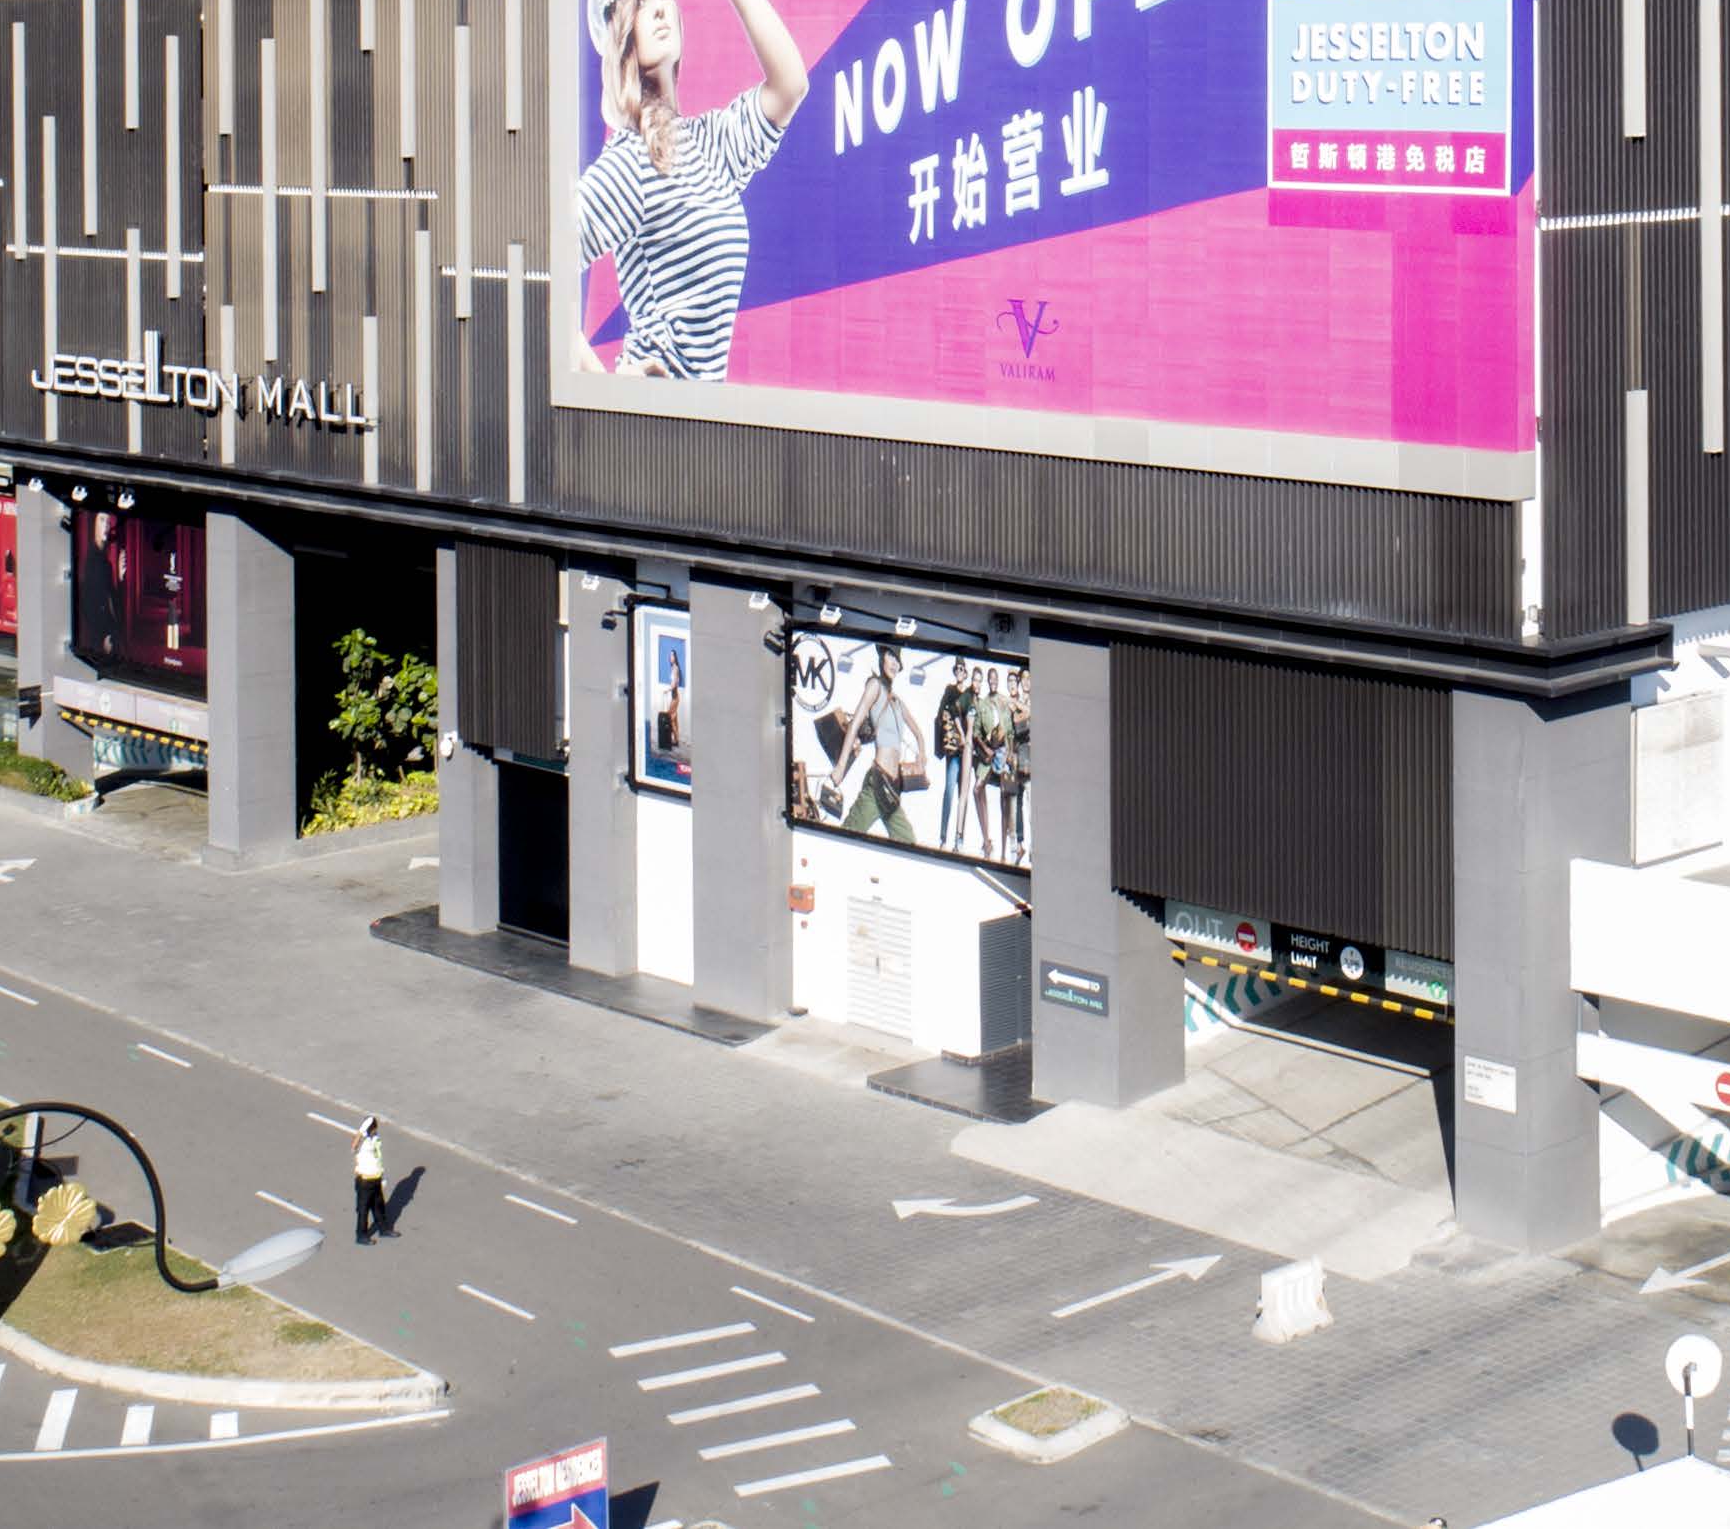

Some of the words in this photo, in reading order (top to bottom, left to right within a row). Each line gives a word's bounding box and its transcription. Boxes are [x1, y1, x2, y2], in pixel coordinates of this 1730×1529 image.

[1290, 21, 1486, 63] JESSELTON
[1290, 70, 1487, 106] DUTY-FREE
[907, 85, 1110, 247] 开始营业
[31, 330, 238, 410] JESSELTON
[258, 374, 367, 424] MALL
[1000, 362, 1055, 382] VALIRAM
[792, 654, 831, 689] MK
[1291, 933, 1330, 953] HEIGHT
